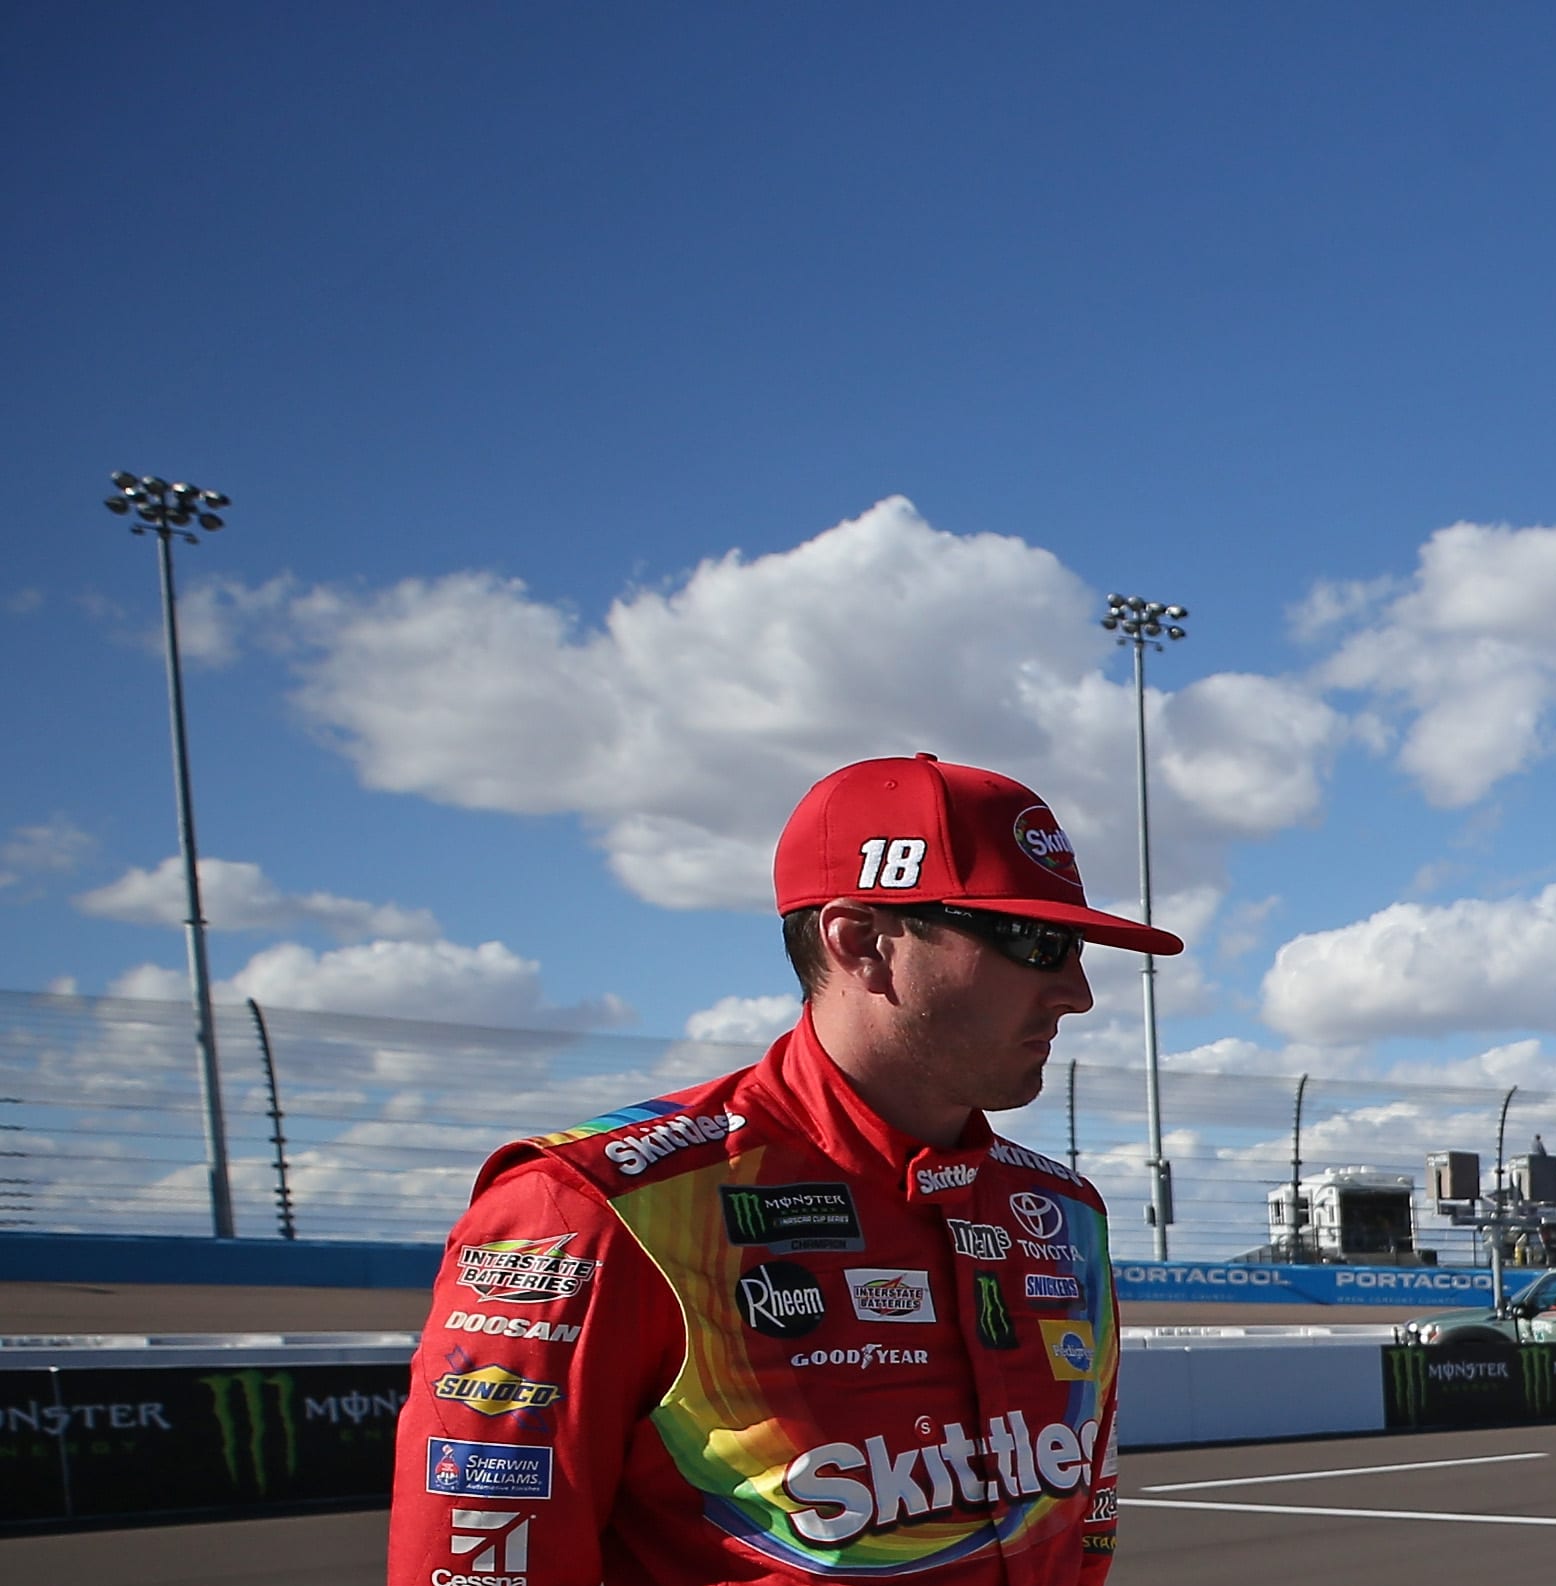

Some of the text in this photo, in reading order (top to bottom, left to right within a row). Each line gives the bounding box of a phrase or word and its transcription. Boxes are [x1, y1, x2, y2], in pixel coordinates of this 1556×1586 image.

[858, 838, 927, 889] 18
[605, 1111, 747, 1176] Skittles
[764, 1194, 846, 1209] MONSTER
[462, 1248, 594, 1278] INTERSTATE
[1017, 1240, 1085, 1262] TOYOTA
[463, 1268, 580, 1295] BATTERIES
[854, 1286, 923, 1300] INTERSTATE
[1026, 1275, 1078, 1297] SNICKERS
[740, 1264, 825, 1329] Rheem
[859, 1298, 922, 1311] BATTERIES
[444, 1312, 581, 1343] DOOSAN
[1428, 1361, 1510, 1380] MONSTER
[438, 1376, 555, 1405] SUNOCO
[304, 1389, 409, 1424] MON
[466, 1453, 540, 1471] SHERWIN
[464, 1468, 542, 1485] WILLIAMS
